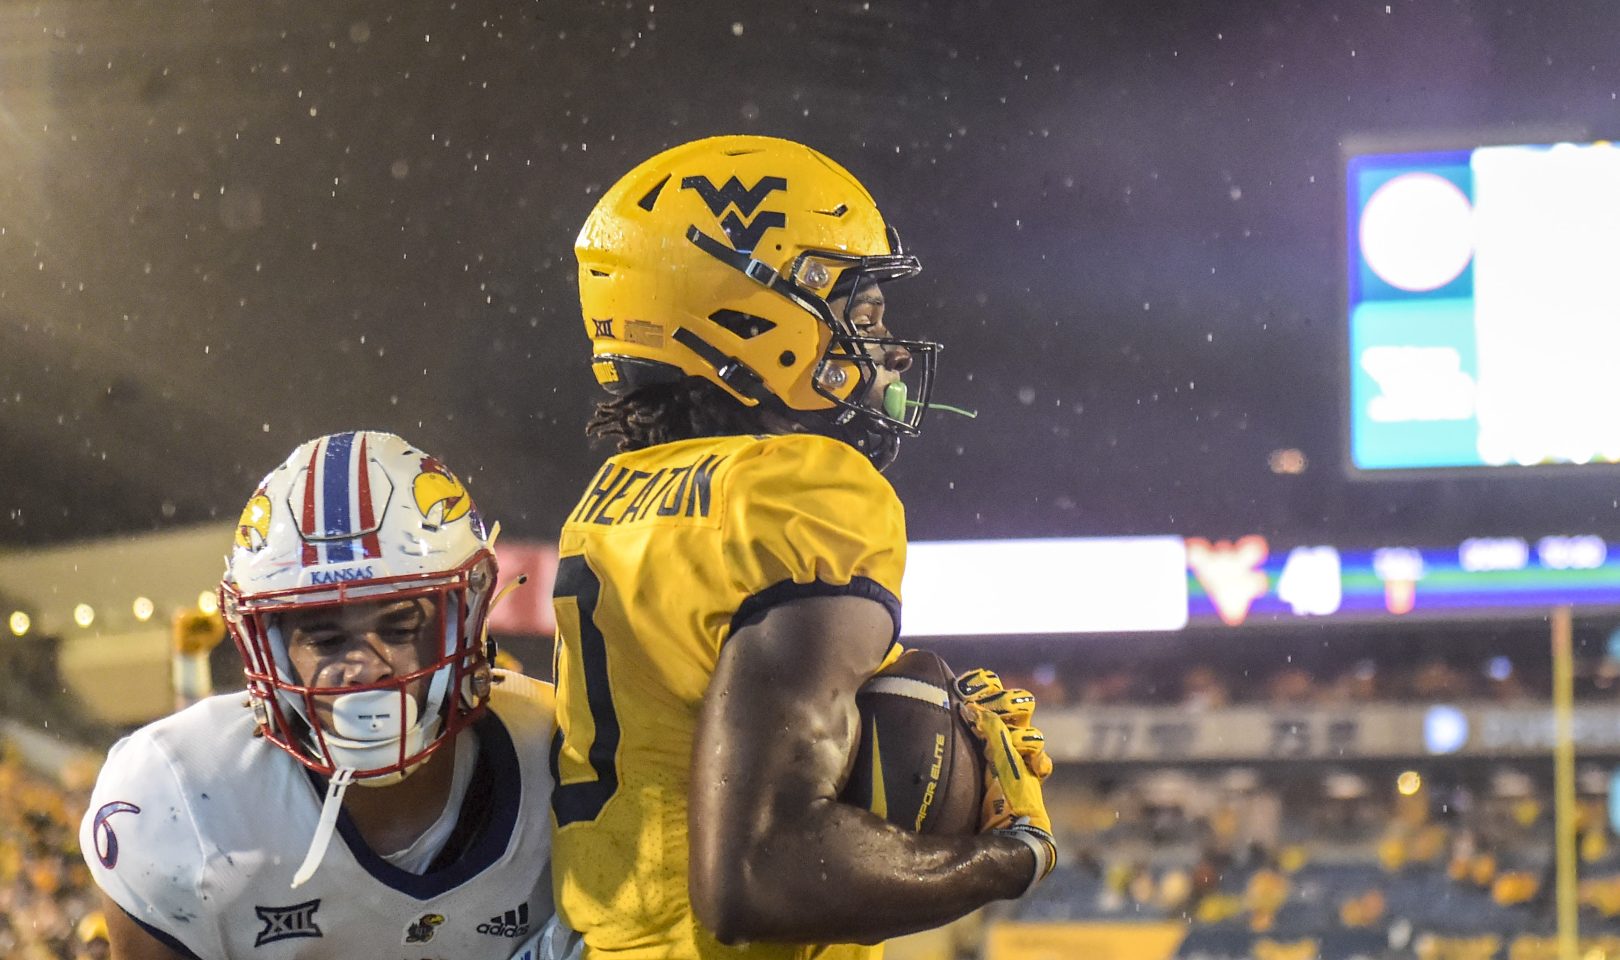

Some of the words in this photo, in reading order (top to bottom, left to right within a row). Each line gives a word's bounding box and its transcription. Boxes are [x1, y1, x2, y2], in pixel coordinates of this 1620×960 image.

[573, 454, 731, 525] HEATON
[310, 565, 373, 585] KANSAS
[915, 781, 937, 833] APOR
[930, 732, 945, 780] ELITE
[93, 800, 141, 870] 6
[254, 898, 323, 948] XII
[476, 922, 530, 938] adidas
